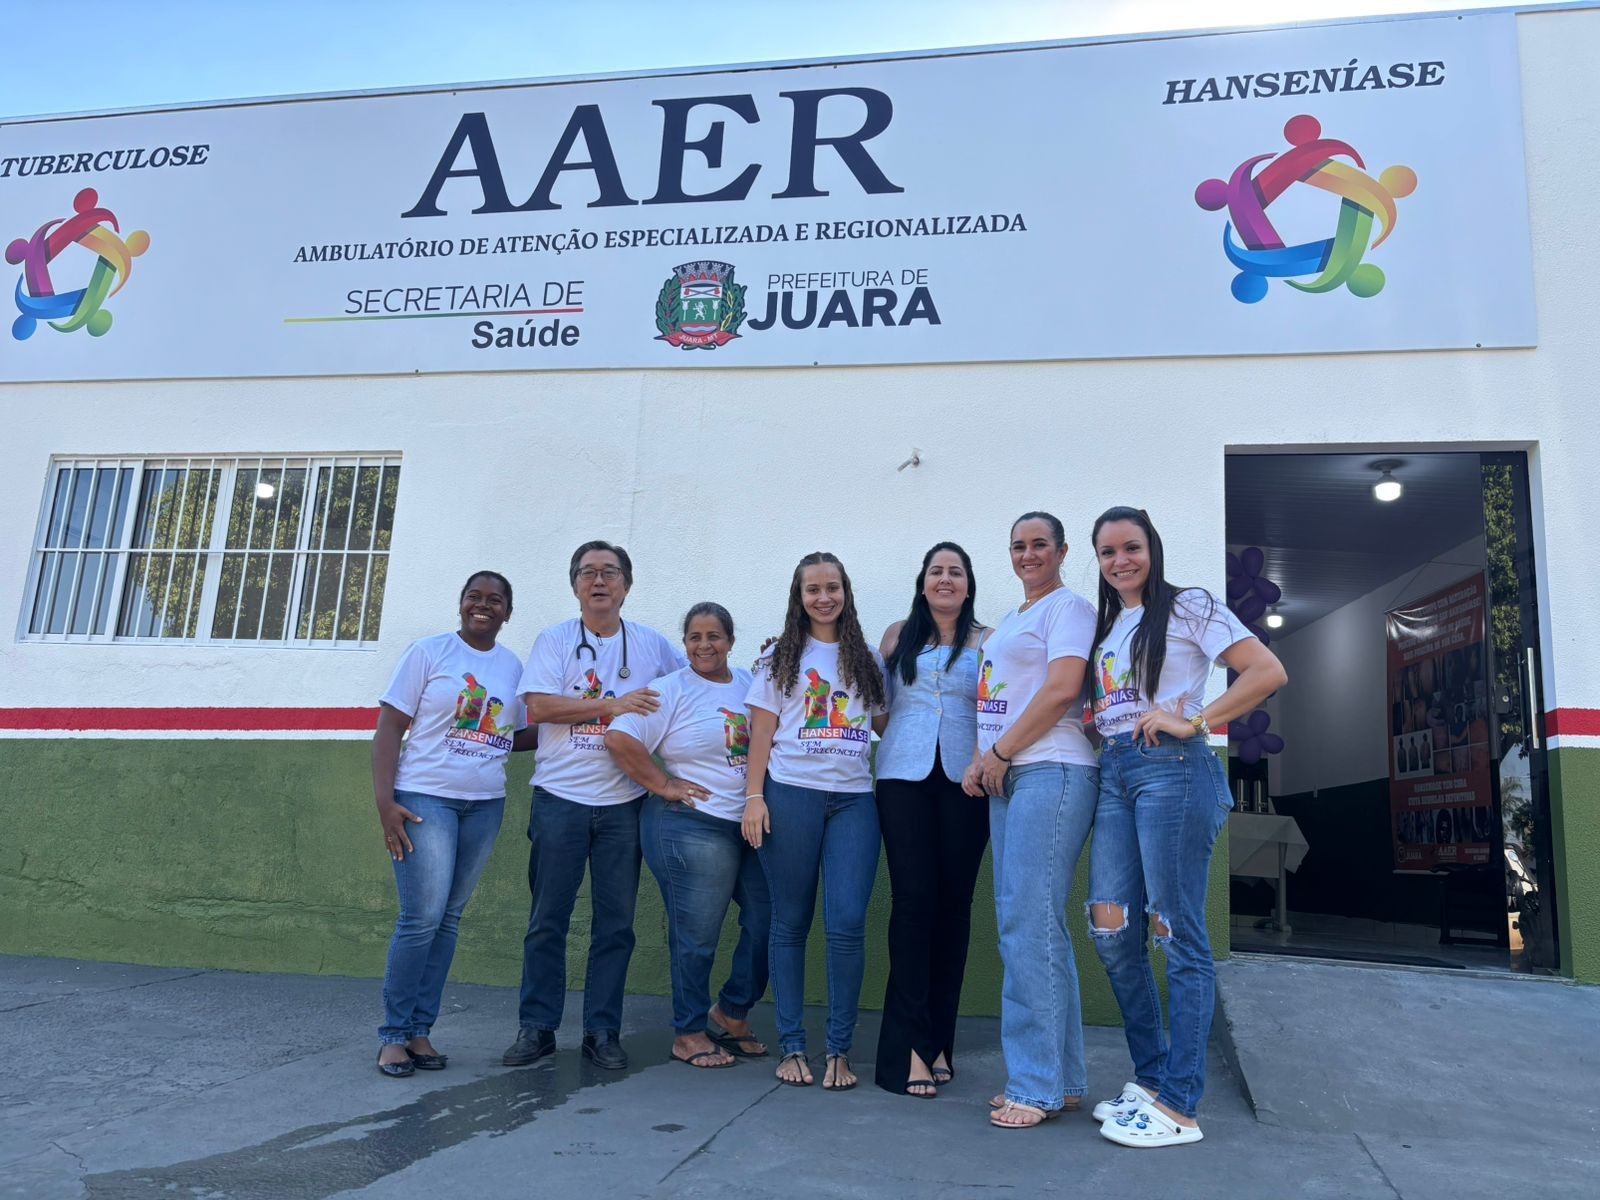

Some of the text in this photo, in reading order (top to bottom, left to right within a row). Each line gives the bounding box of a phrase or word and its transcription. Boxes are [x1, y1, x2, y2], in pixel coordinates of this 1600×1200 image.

[1163, 59, 1445, 105] HANSENÍASE
[0, 144, 210, 178] TUBERCULOSE
[401, 86, 905, 218] AAER
[293, 213, 1028, 263] AMBULATÓRIO DE ATENÇÃO ESPECIALIZADA E REGIONALIZADA
[345, 281, 585, 315] SECRETARIA DE
[767, 269, 929, 290] PREFEITURA DE
[747, 286, 942, 331] JUARA
[471, 318, 580, 349] Saúde
